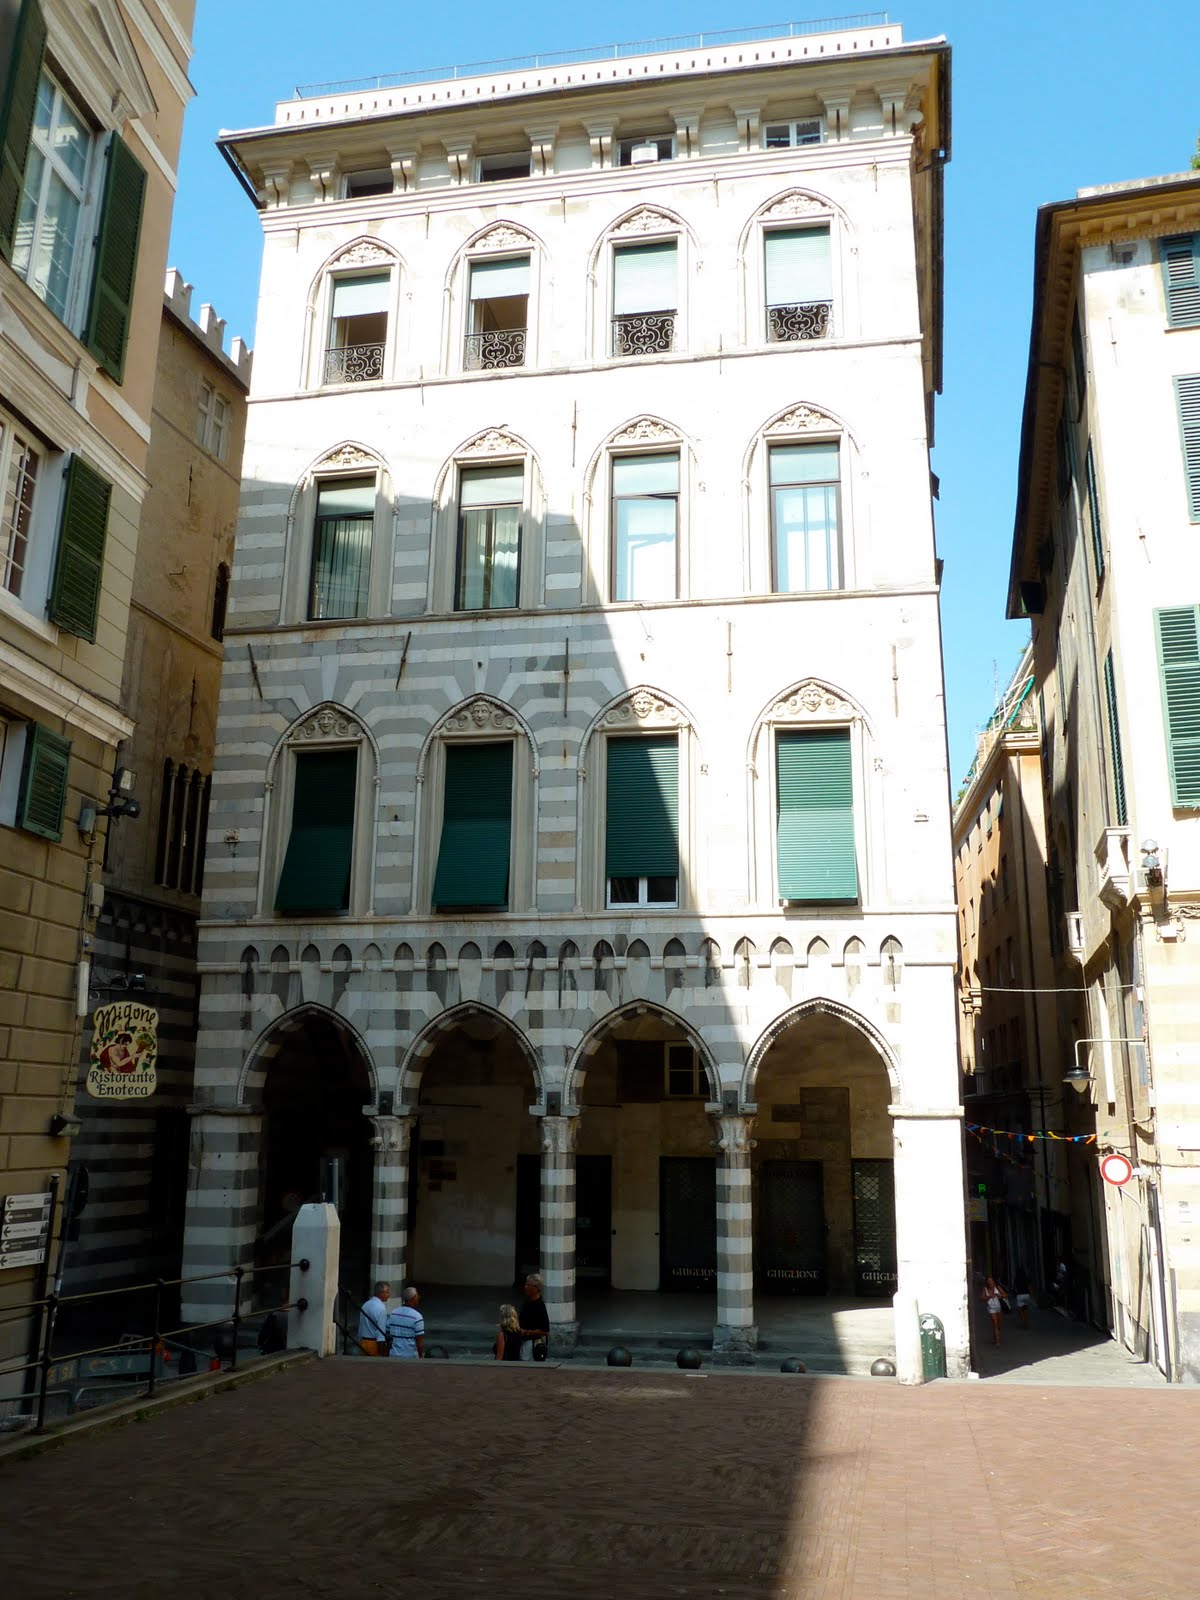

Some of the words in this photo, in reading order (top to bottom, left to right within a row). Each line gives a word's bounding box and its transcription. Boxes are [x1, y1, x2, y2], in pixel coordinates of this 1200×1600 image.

[96, 1004, 156, 1037] Migone
[90, 1071, 155, 1084] Ristorante
[96, 1084, 148, 1095] Enoteca
[673, 1267, 717, 1277] GHIGLION
